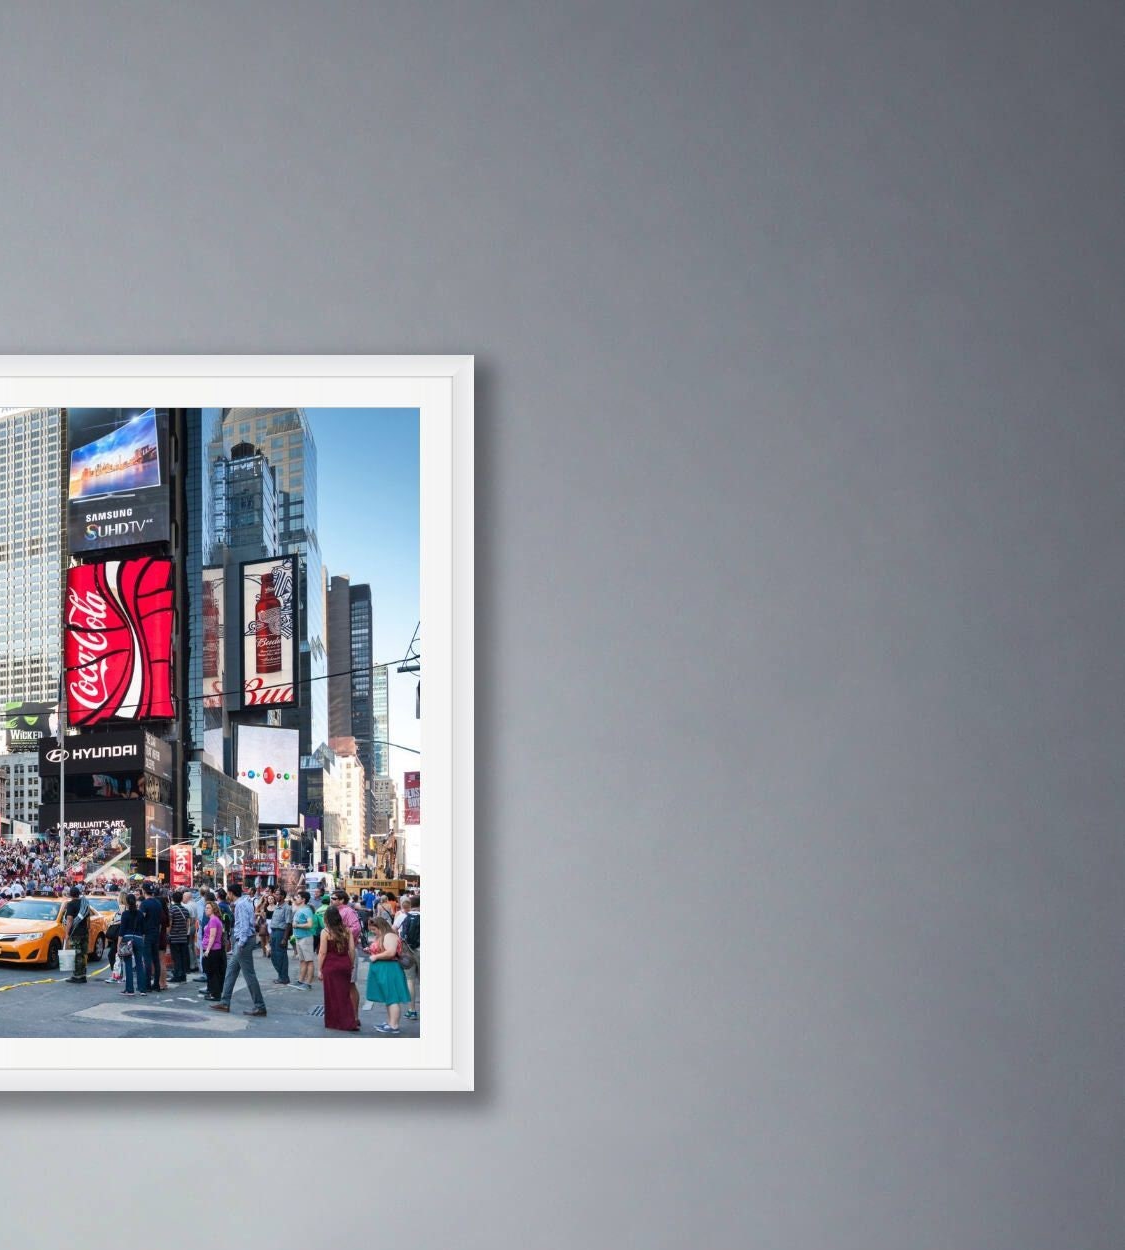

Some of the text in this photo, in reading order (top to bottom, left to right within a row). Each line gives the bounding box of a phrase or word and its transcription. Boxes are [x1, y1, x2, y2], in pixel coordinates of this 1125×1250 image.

[85, 508, 133, 523] SAMSUNG
[68, 587, 108, 709] Coca-Cola
[72, 744, 137, 760] HYUNDAI
[175, 847, 189, 873] tkts
